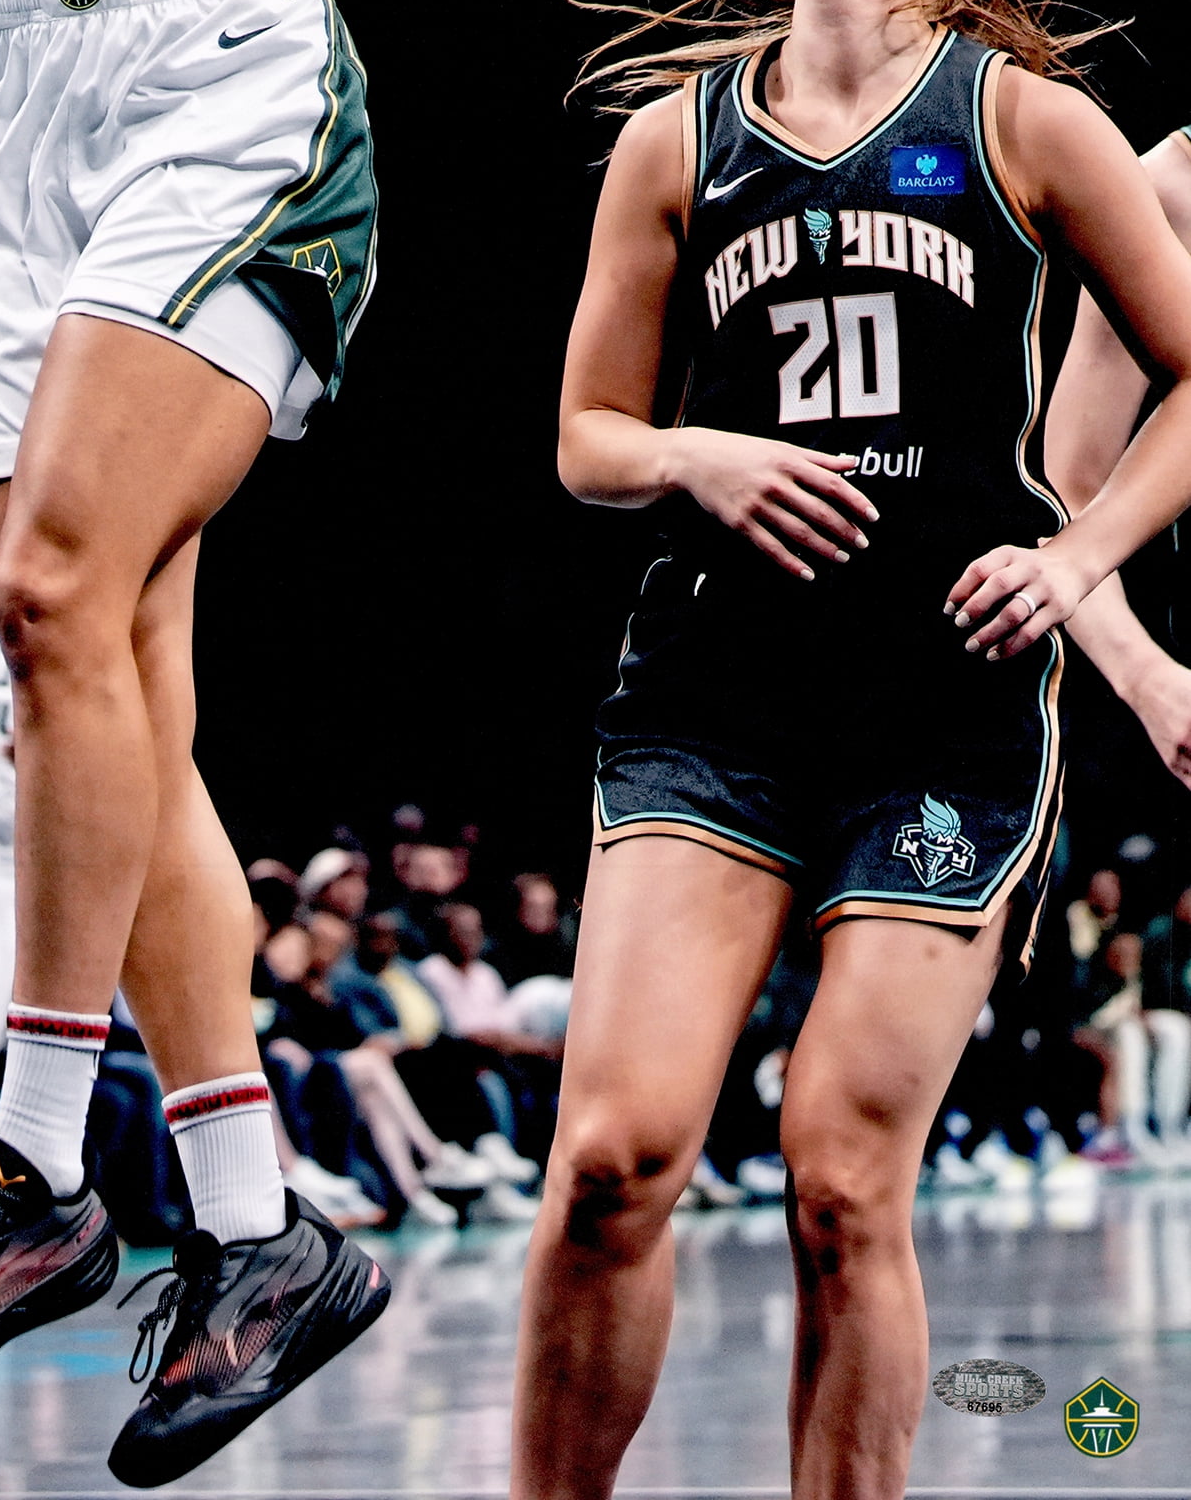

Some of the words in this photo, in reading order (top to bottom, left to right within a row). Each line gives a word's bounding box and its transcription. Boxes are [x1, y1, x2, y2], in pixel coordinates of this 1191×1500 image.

[897, 174, 956, 189] BARCLAYS
[704, 214, 799, 332] NEW
[837, 209, 975, 309] YORK
[767, 291, 901, 425] 20
[836, 445, 924, 478] bull
[954, 1372, 983, 1384] MILL
[987, 1374, 1025, 1386] CREEK
[953, 1382, 1025, 1399] SPORTS
[966, 1401, 1004, 1413] 67695
